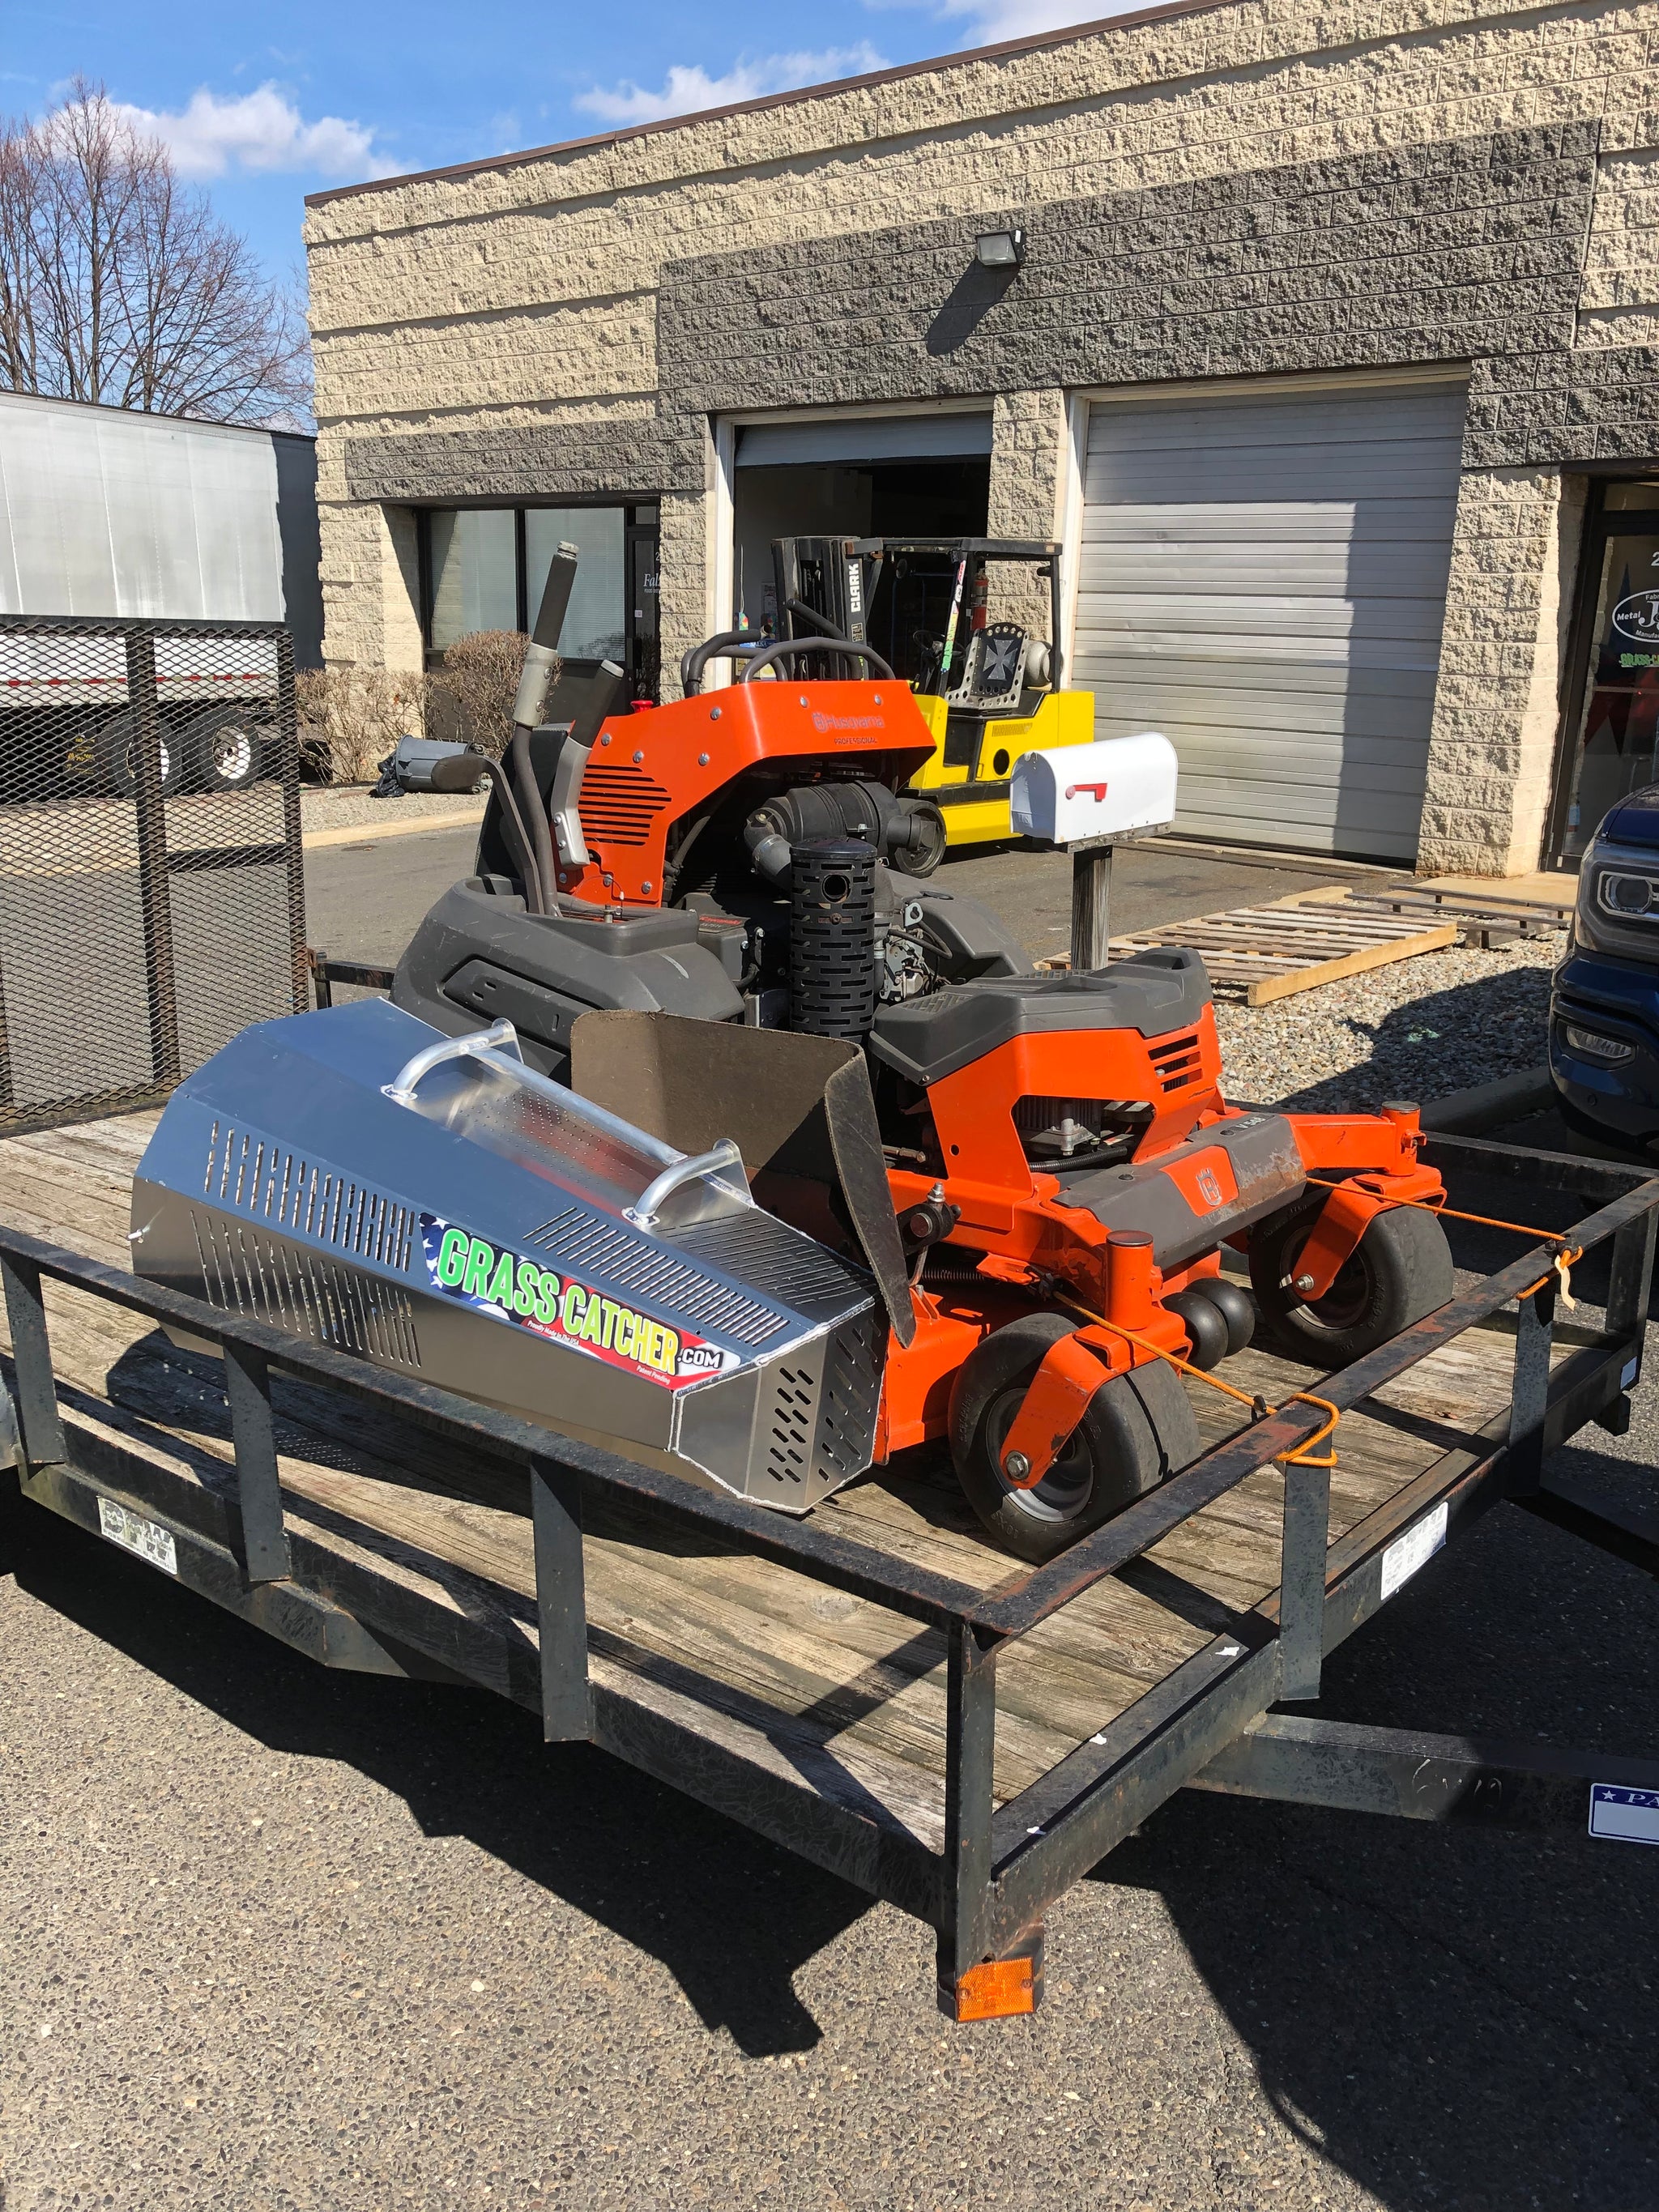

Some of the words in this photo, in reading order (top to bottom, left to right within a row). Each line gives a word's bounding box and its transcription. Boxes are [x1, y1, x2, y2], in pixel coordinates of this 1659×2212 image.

[848, 563, 861, 612] CLARK
[1617, 611, 1641, 621] Metal
[825, 714, 885, 730] Husqvarna
[436, 1228, 560, 1325] GRASS
[527, 1320, 545, 1332] Proudly
[544, 1327, 557, 1337] Made
[562, 1334, 571, 1342] The
[569, 1337, 580, 1345] USA
[636, 1365, 653, 1376] Patent
[651, 1370, 671, 1385] Pending
